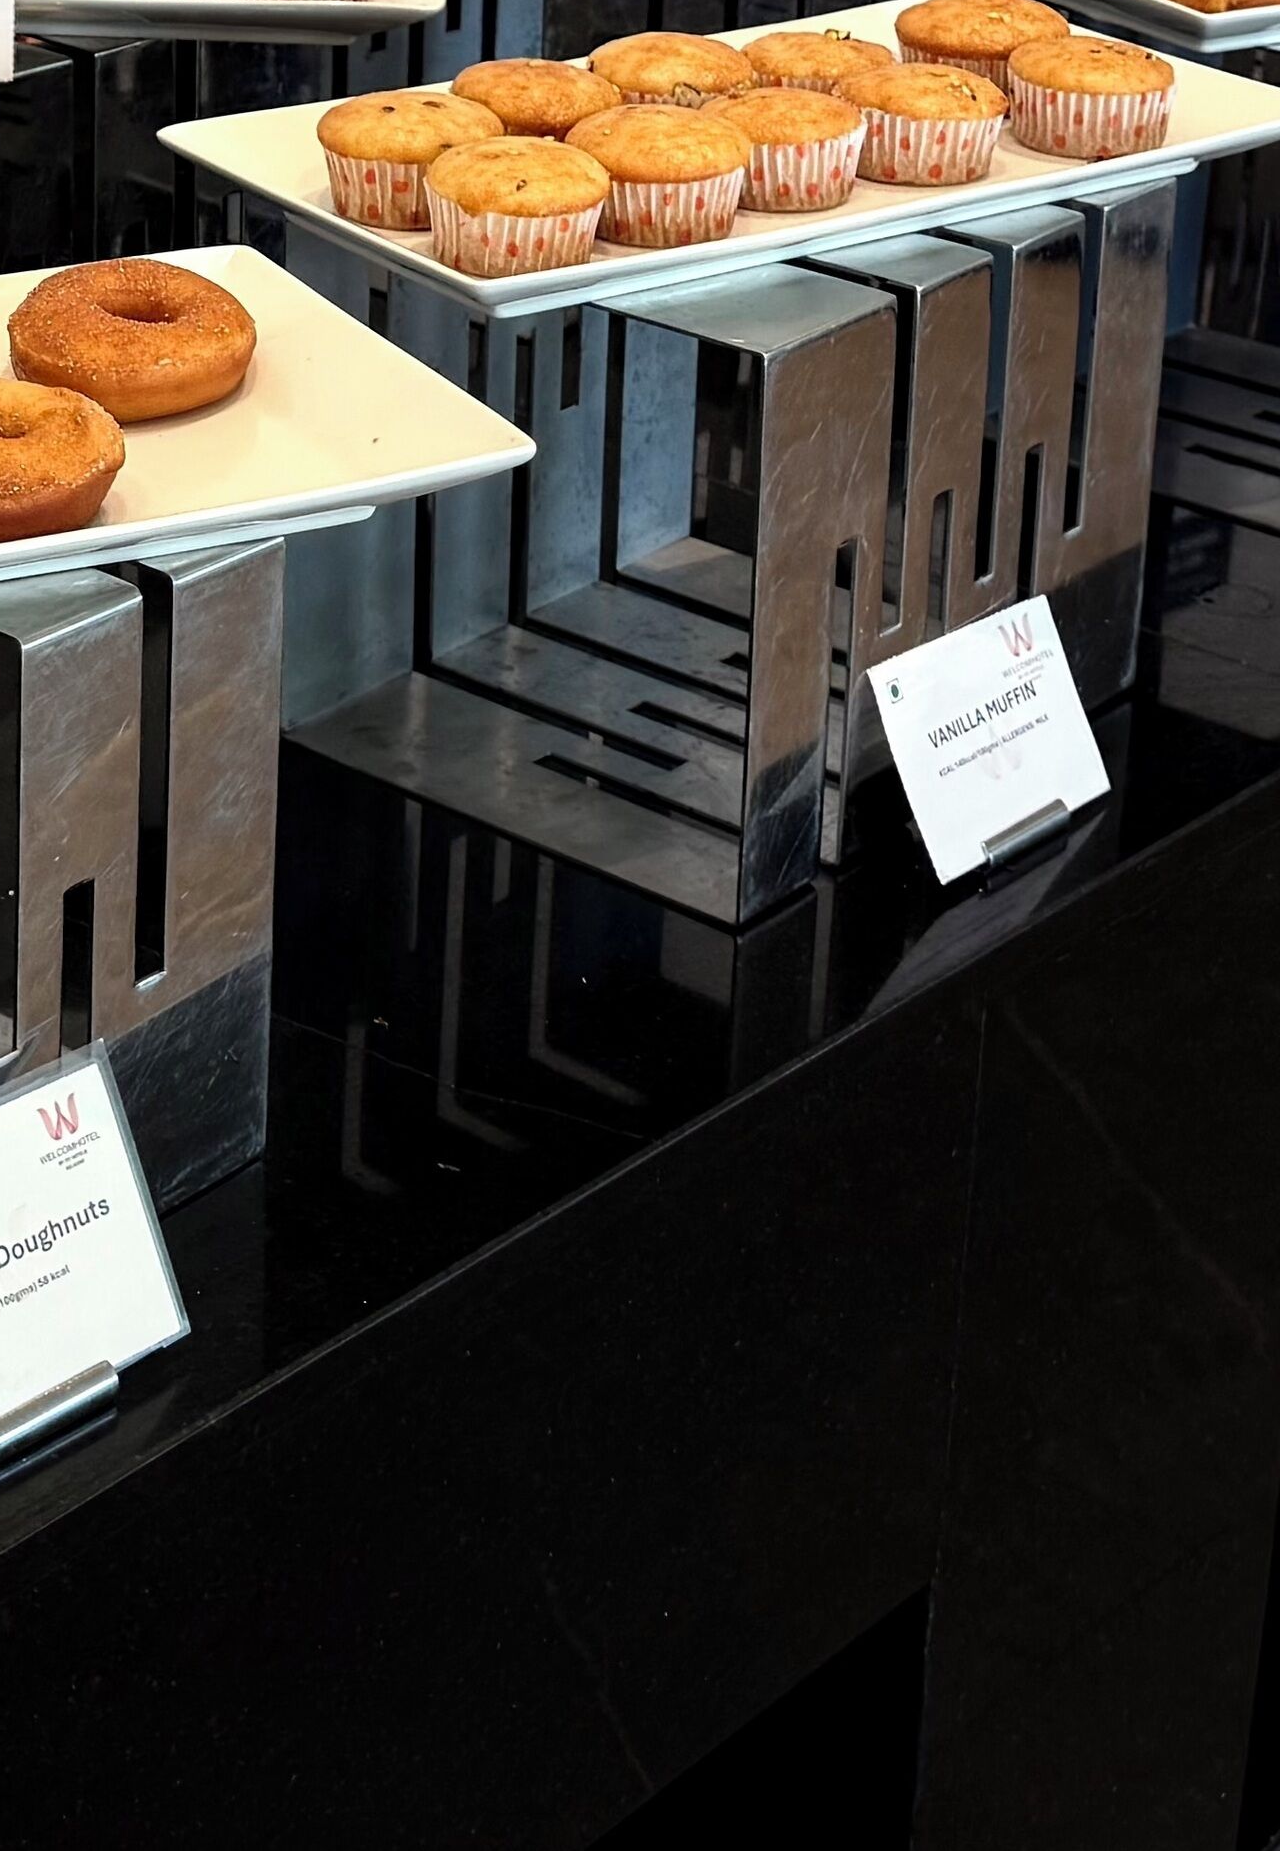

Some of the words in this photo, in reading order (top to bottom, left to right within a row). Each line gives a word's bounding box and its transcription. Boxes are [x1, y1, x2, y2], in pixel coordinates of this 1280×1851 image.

[928, 707, 988, 748] VANILLA
[985, 680, 1037, 720] MUFFIN
[39, 1131, 101, 1165] WELCOMHOTEL
